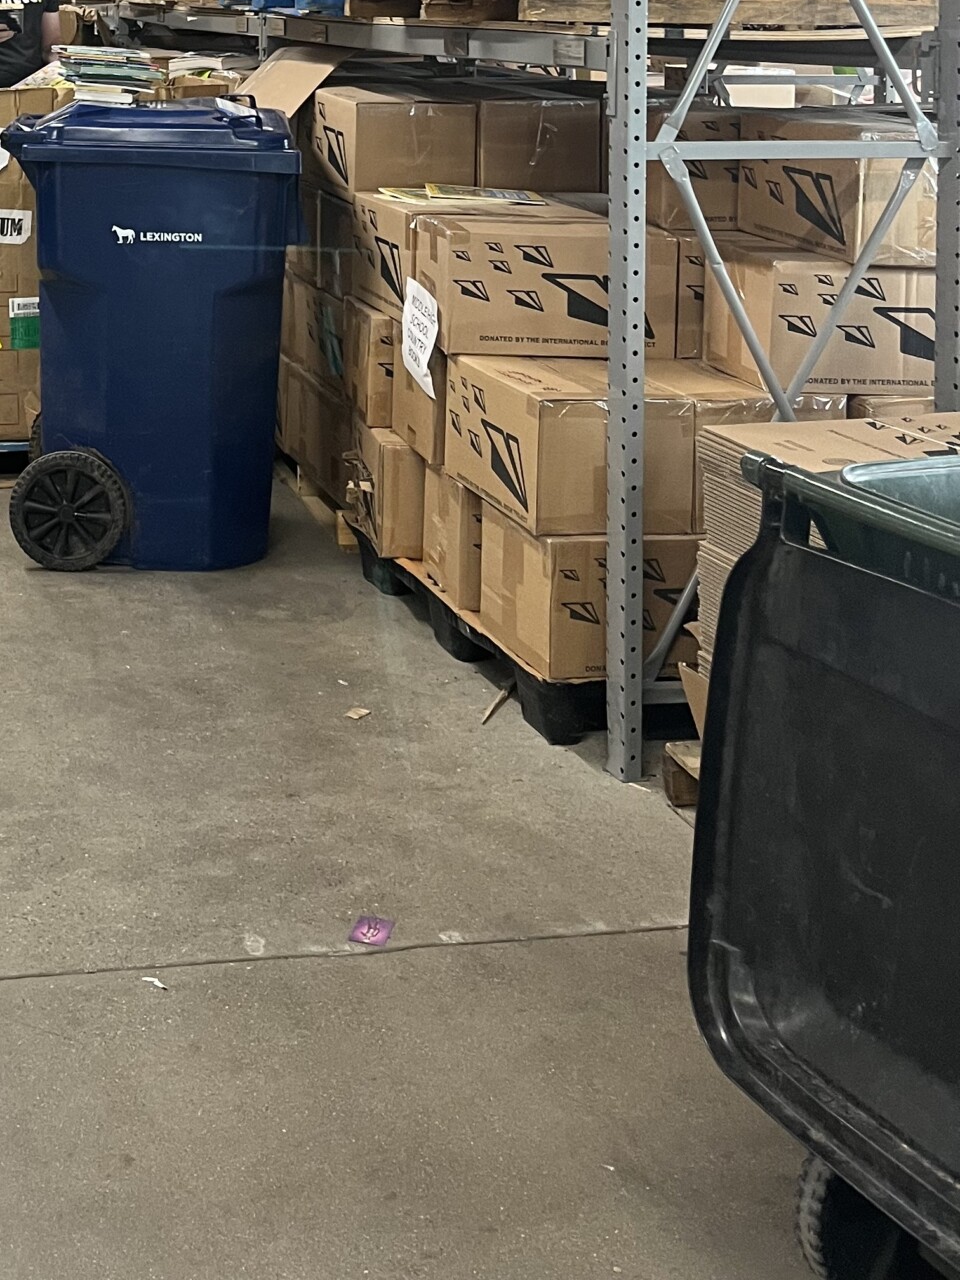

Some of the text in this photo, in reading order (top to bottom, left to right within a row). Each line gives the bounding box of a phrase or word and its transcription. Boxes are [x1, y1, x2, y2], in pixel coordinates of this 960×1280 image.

[140, 231, 203, 243] LEXINGTON
[479, 335, 513, 343] DONATED
[541, 338, 599, 346] INTERNATIONAL
[805, 377, 839, 385] ONATED
[852, 378, 868, 386] THE
[869, 379, 930, 387] INTERNATIONAL
